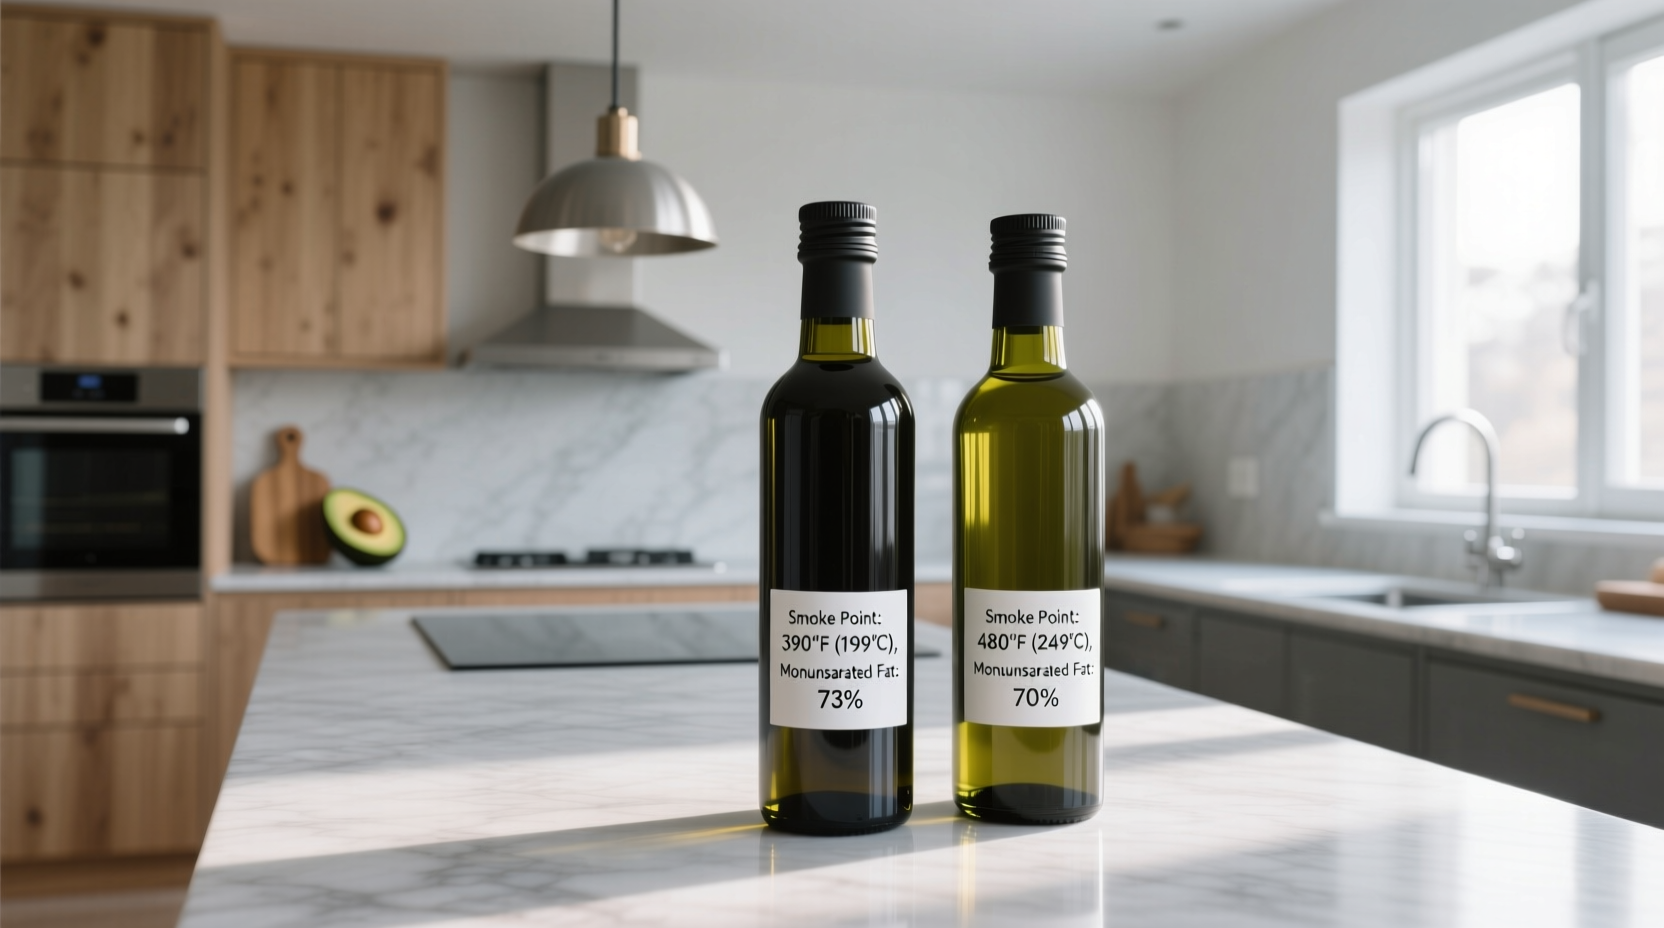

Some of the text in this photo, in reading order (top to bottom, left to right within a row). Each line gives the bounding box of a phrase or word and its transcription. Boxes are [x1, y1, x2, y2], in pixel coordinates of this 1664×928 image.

[788, 609, 882, 626] Smoke Point:
[985, 608, 1080, 625] Smoke Point:
[877, 663, 900, 679] Fat:
[1073, 661, 1095, 677] Fat:
[817, 689, 864, 710] 73%
[1013, 687, 1059, 708] 70%
